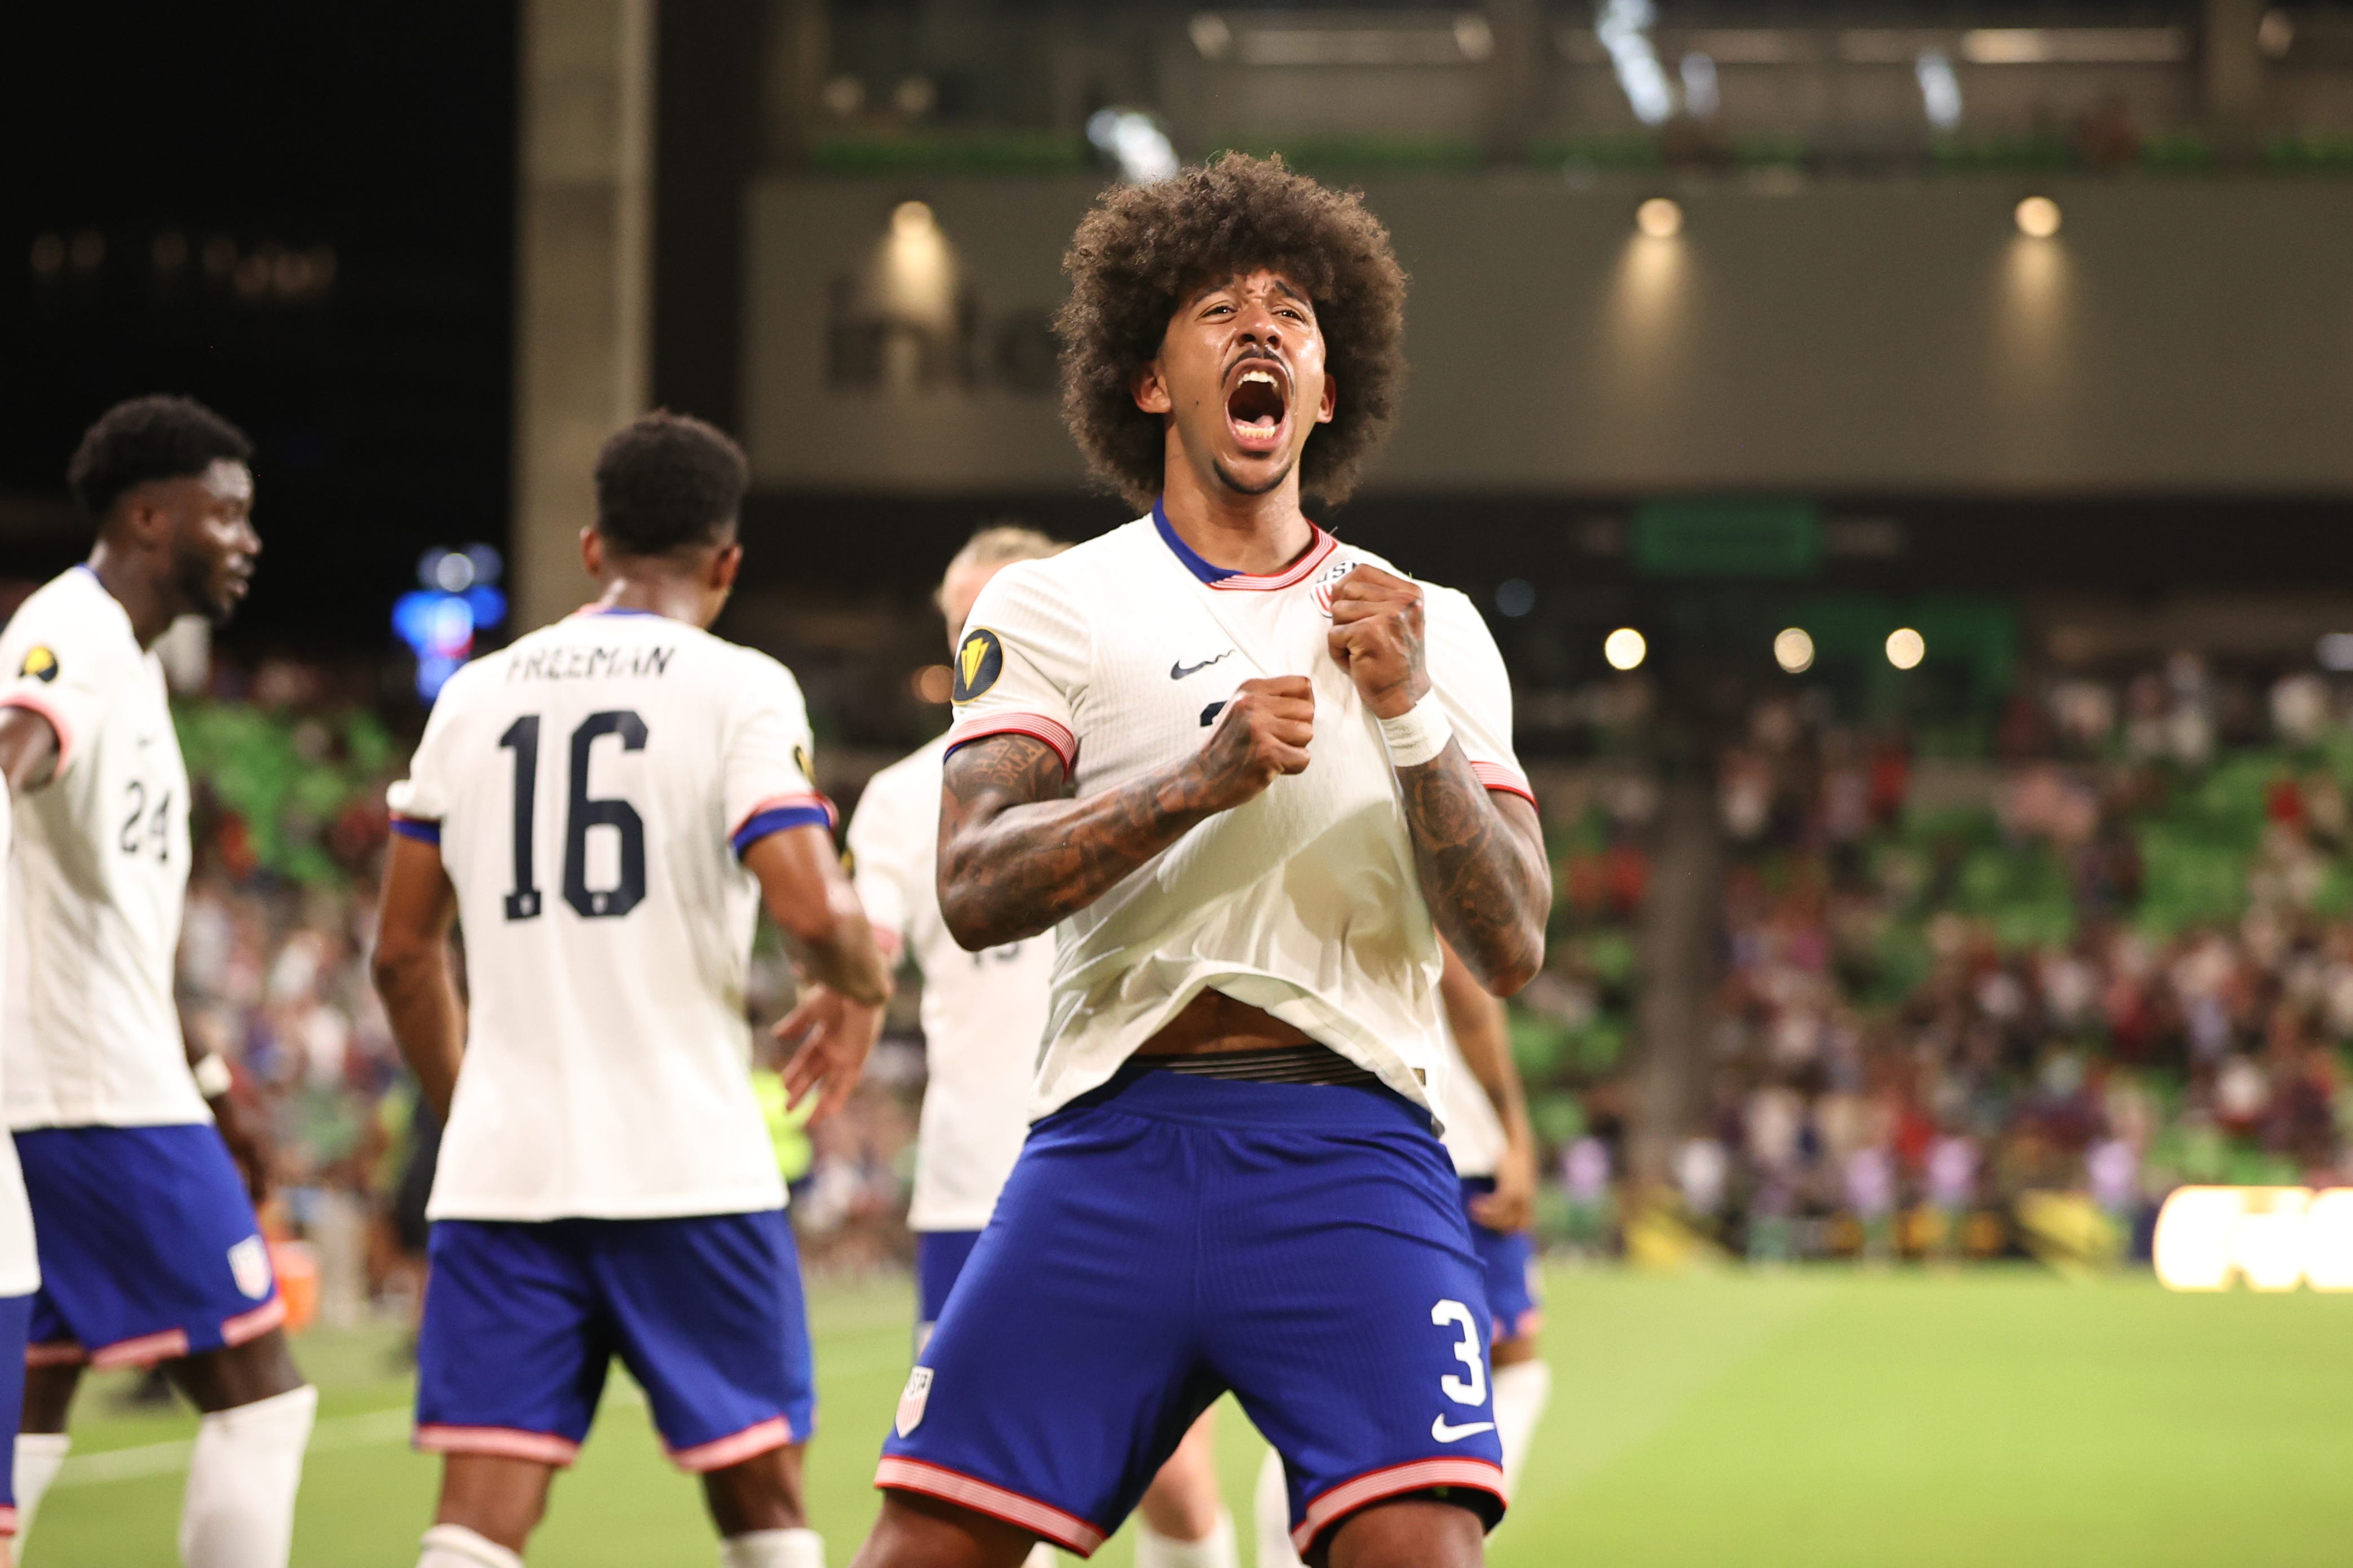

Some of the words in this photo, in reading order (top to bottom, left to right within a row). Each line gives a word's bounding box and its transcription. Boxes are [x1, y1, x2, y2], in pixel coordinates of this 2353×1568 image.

[1316, 560, 1357, 584] US
[506, 646, 676, 681] FREEMAN
[119, 780, 172, 863] 24
[499, 711, 649, 920] 16
[1431, 1298, 1488, 1407] 3
